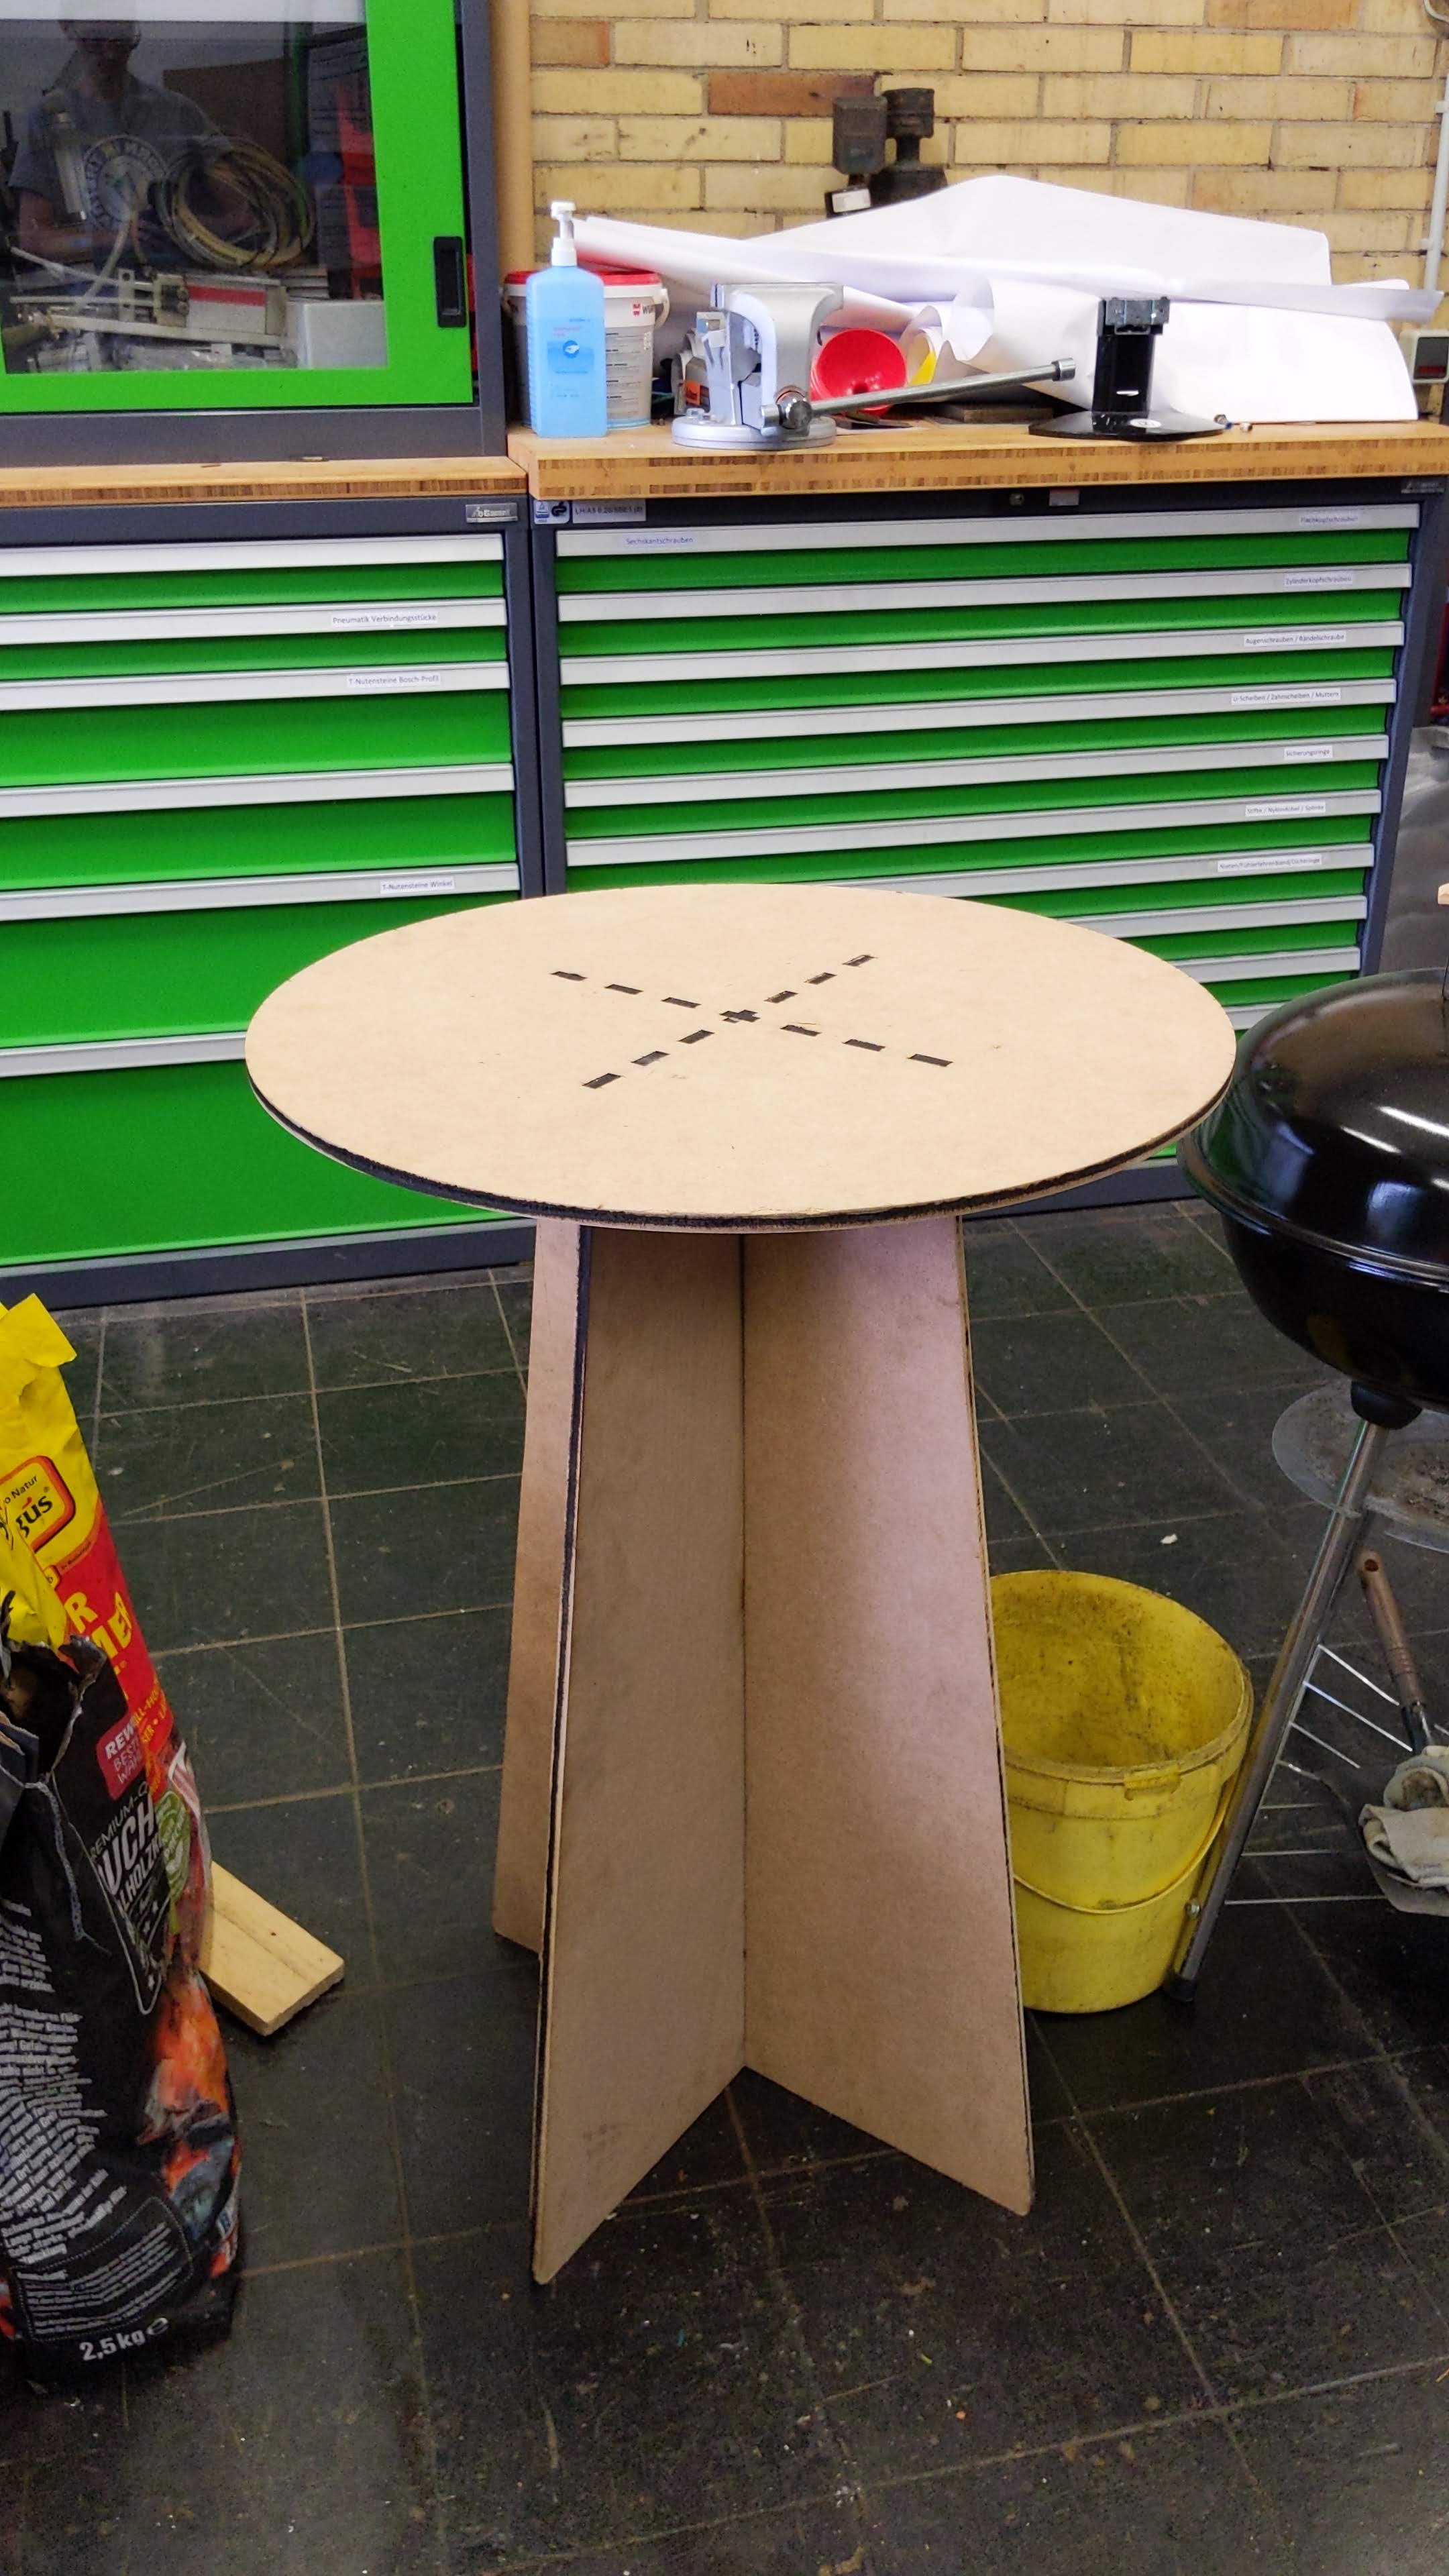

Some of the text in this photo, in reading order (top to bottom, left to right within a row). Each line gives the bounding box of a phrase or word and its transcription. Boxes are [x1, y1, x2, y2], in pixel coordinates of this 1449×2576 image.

[333, 614, 437, 624] Pneumatik Verbindungsstücke
[11, 1476, 38, 1499] Natur
